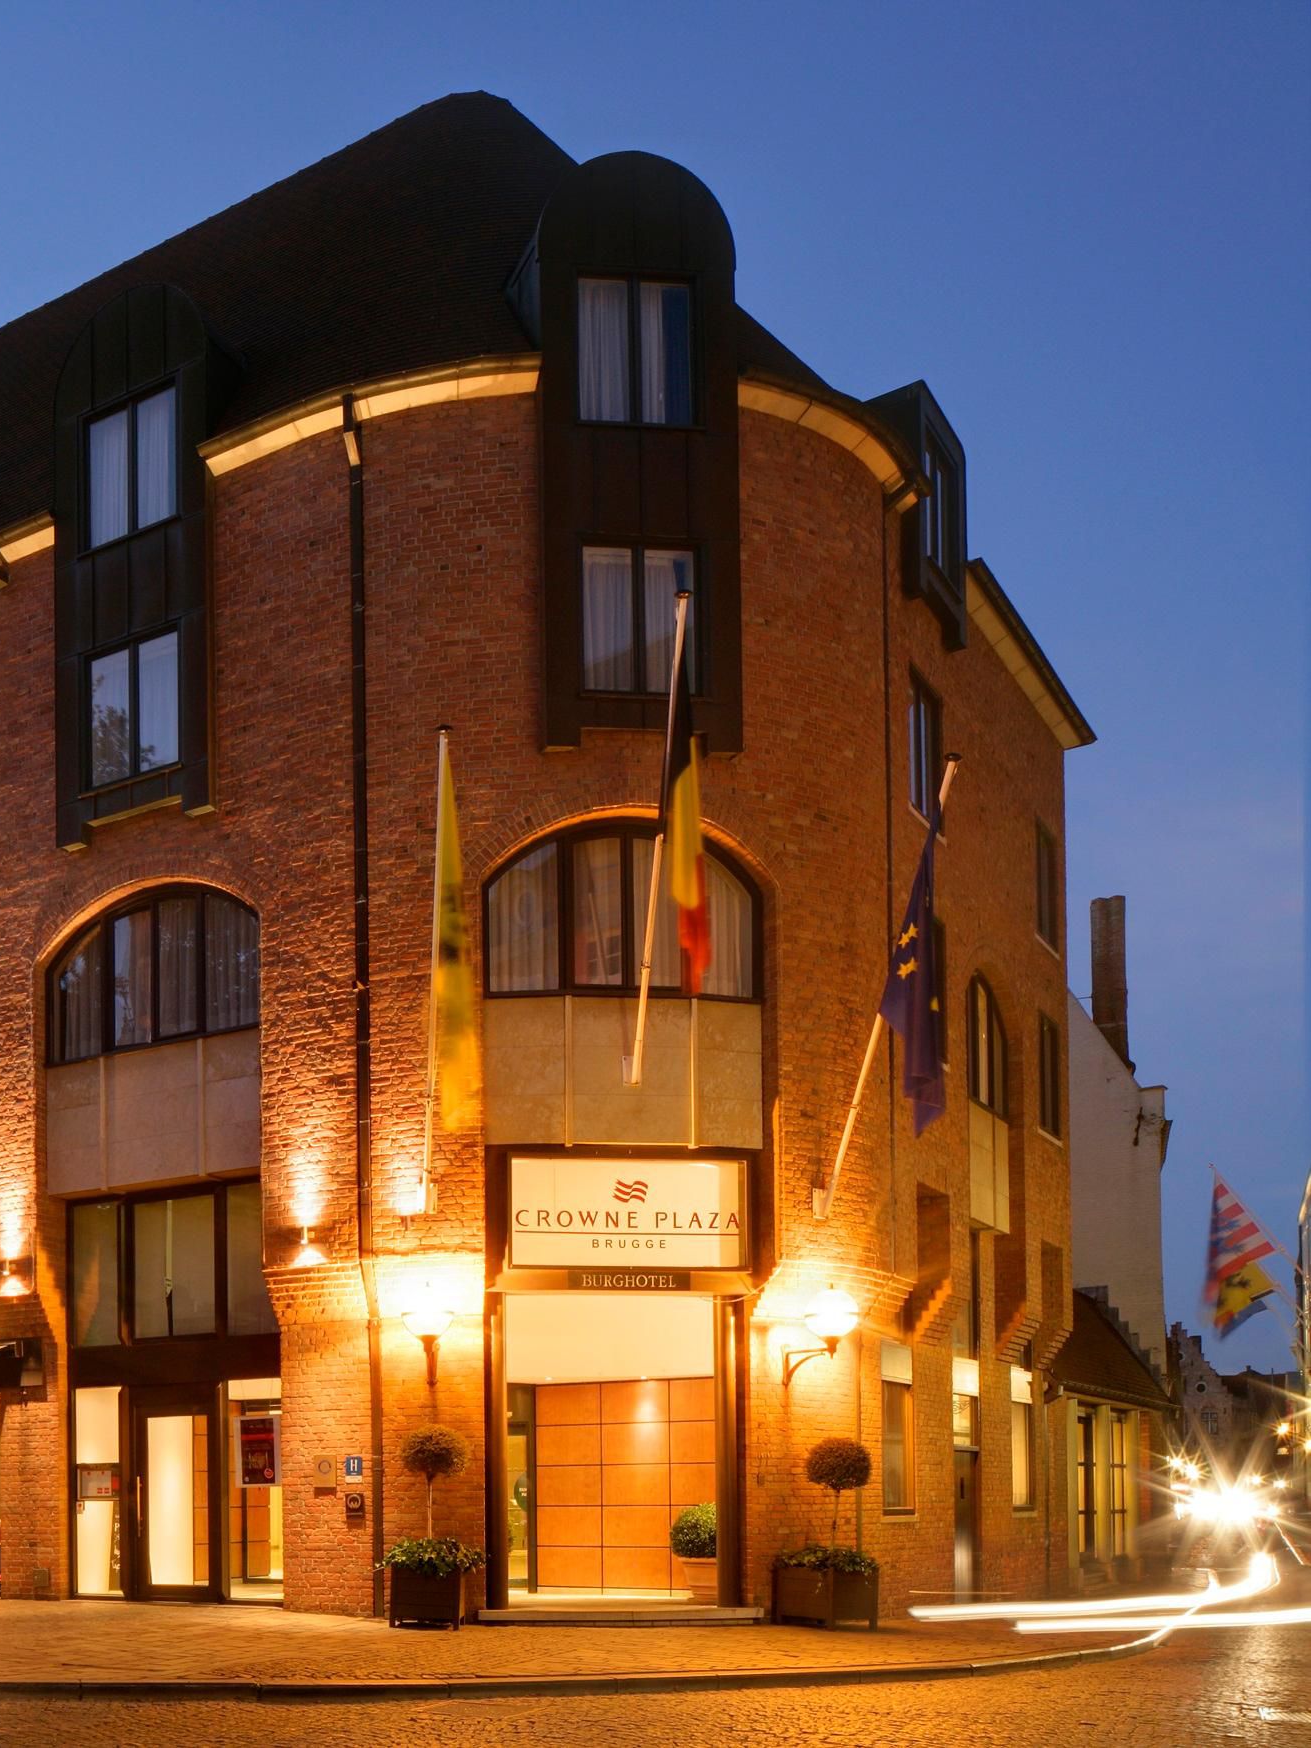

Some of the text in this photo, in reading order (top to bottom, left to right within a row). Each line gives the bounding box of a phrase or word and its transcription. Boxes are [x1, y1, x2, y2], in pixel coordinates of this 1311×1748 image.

[515, 1209, 740, 1229] CROWNE PLAZA
[591, 1238, 666, 1249] BRUGGE
[581, 1273, 677, 1288] BURGHOTEL
[350, 1459, 358, 1471] H
